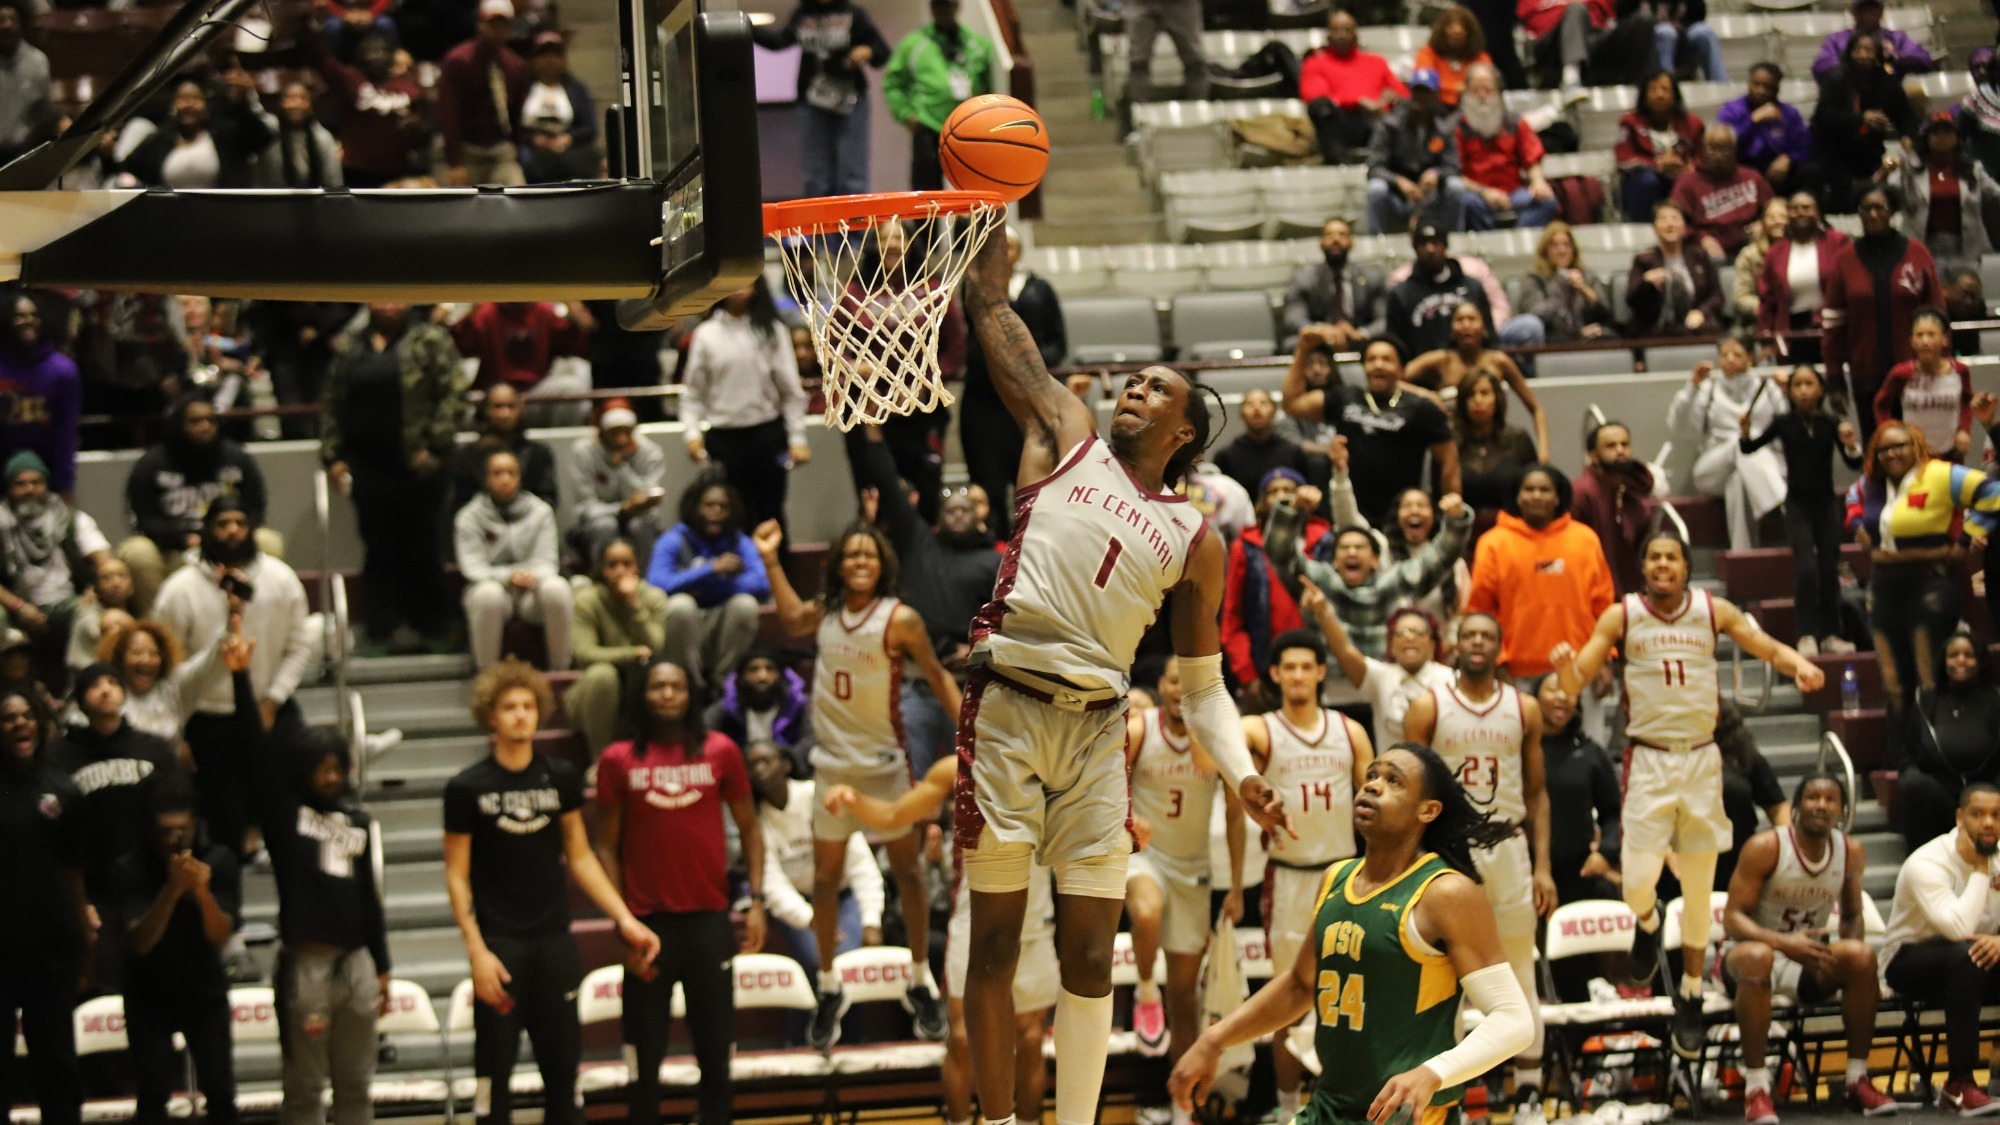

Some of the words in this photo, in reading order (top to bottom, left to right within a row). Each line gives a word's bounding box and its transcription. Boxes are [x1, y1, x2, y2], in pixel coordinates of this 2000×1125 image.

[1067, 485, 1100, 503] NC
[1102, 494, 1173, 576] CENTRAL
[1092, 535, 1125, 591] 1
[835, 670, 851, 700] 0
[1660, 658, 1686, 687] 11
[1463, 755, 1499, 787] 23
[1166, 788, 1183, 818] 3
[1300, 780, 1332, 813] 14
[1559, 914, 1634, 937] NCCU
[739, 970, 793, 989] CCU
[1317, 969, 1366, 1032] 24
